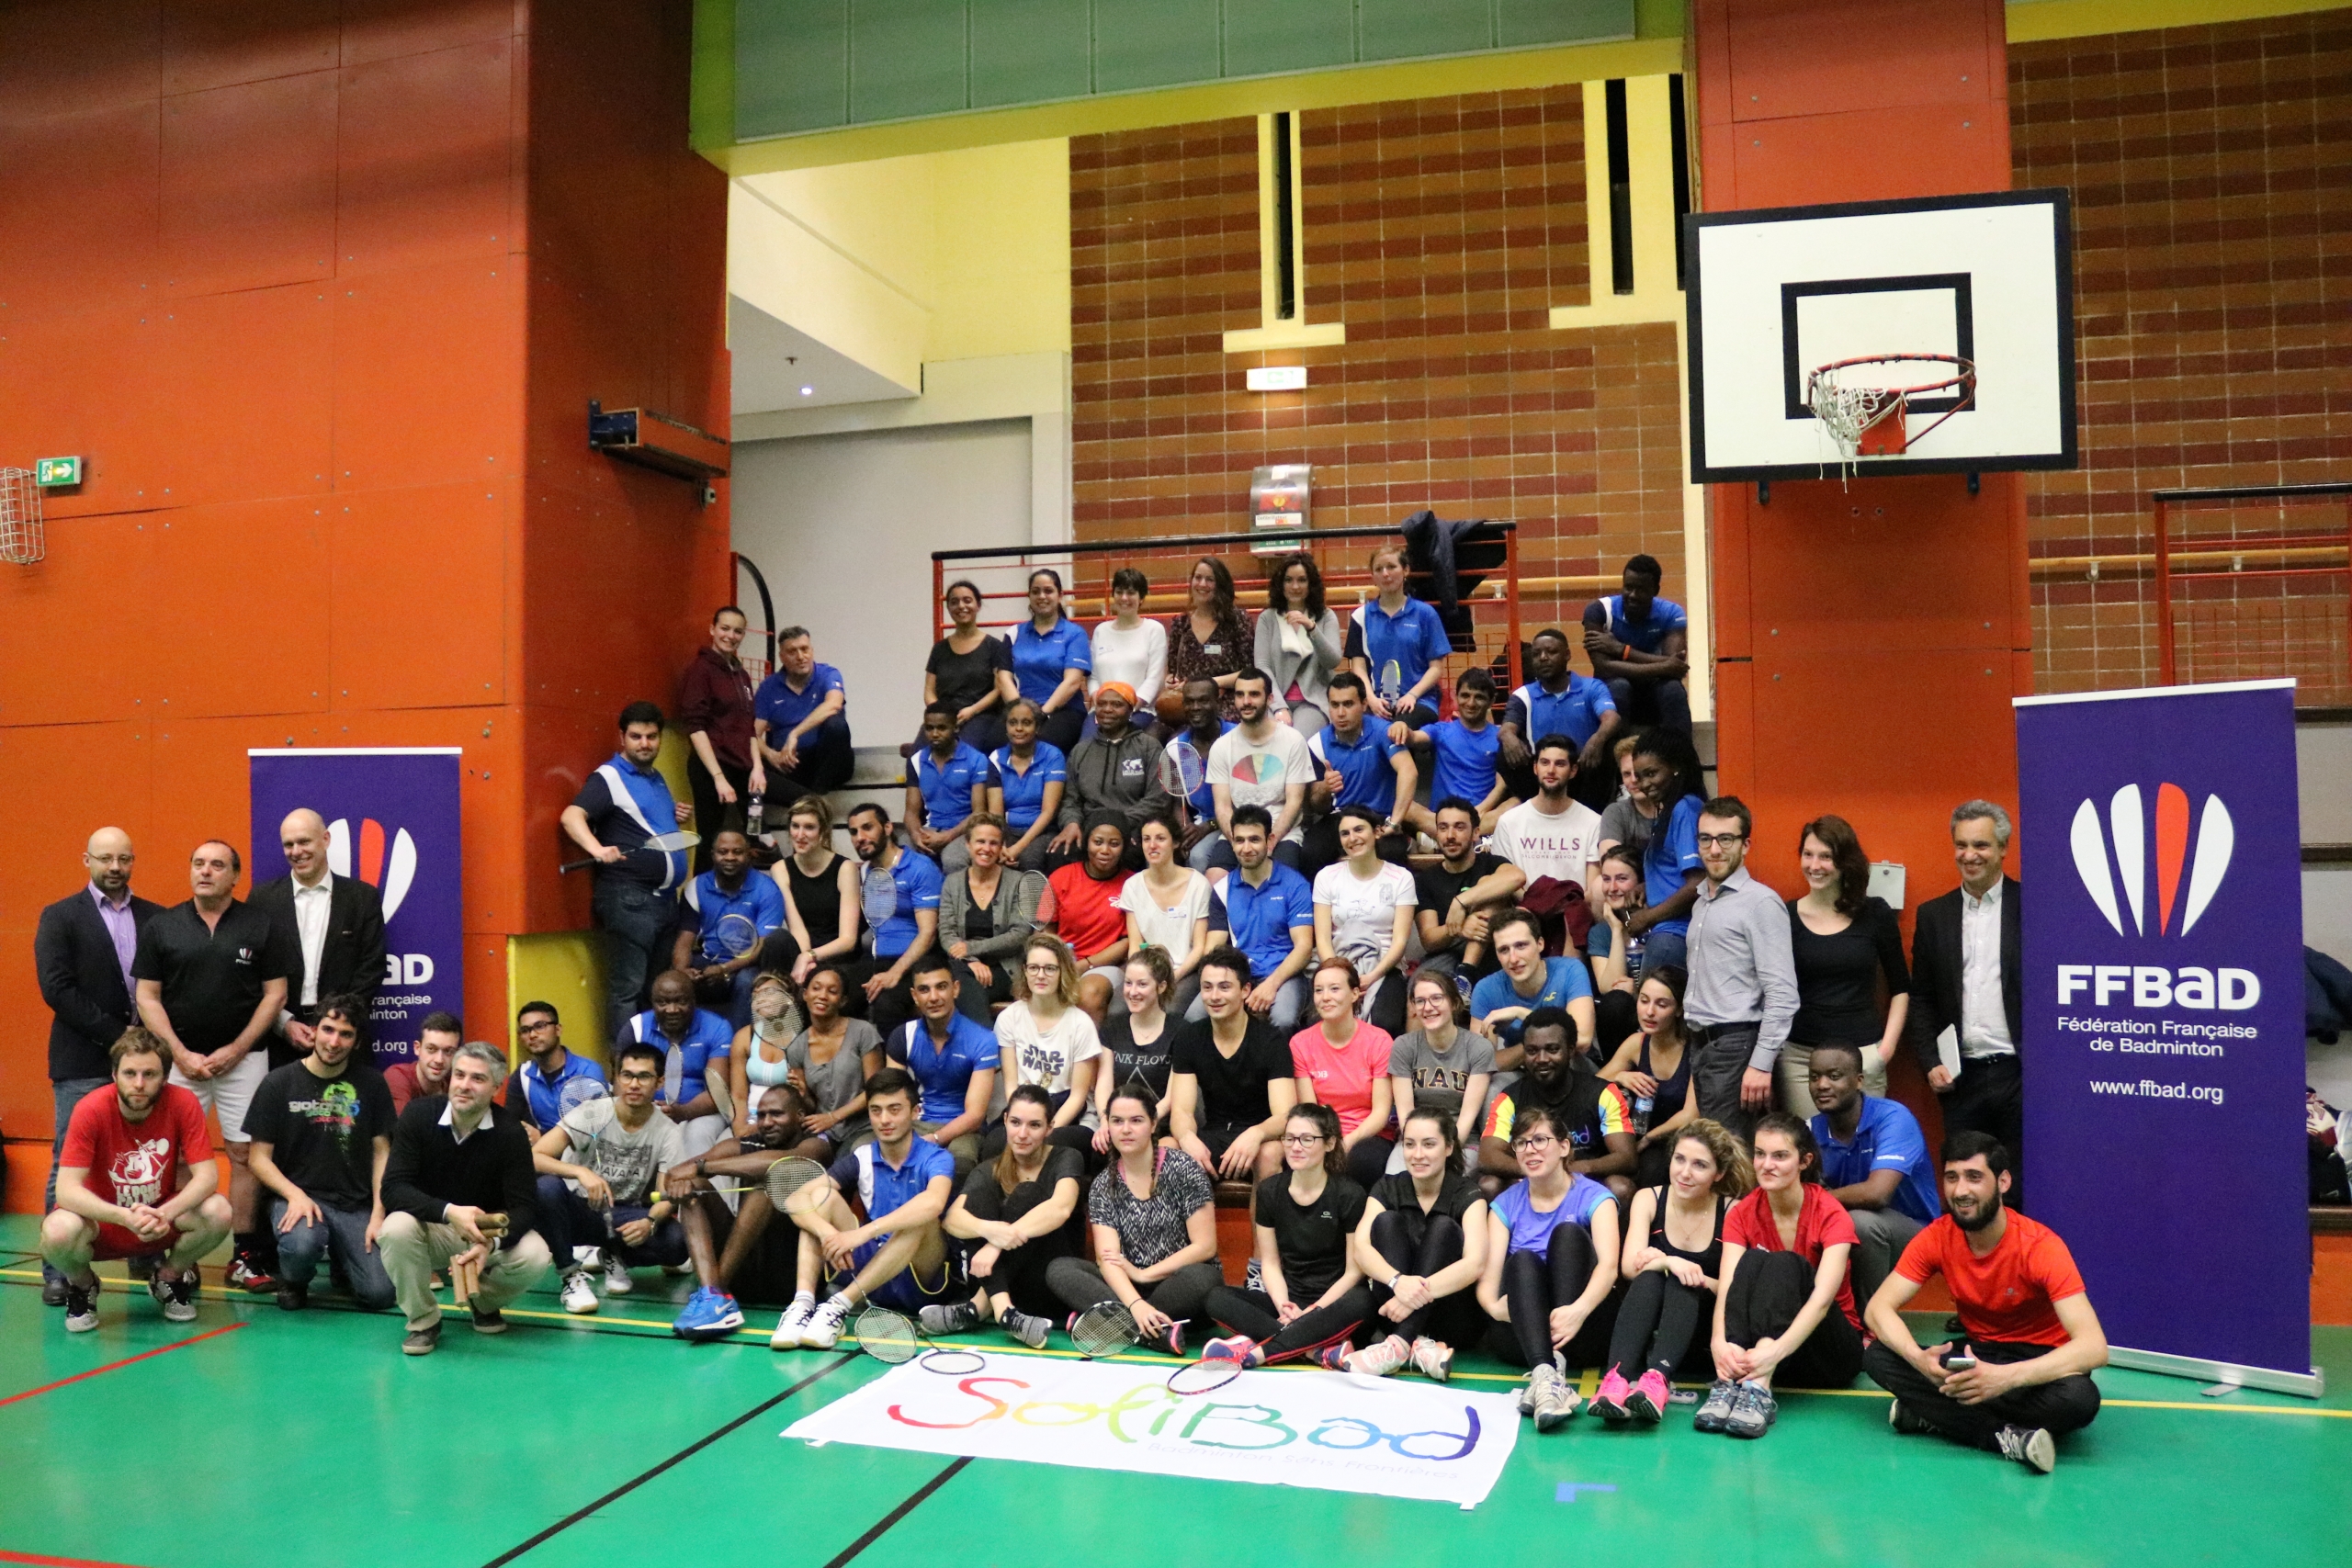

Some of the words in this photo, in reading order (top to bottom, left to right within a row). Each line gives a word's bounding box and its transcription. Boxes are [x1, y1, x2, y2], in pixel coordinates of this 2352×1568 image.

[1520, 837, 1580, 851] WILLS
[372, 993, 432, 1007] rançaise
[369, 1010, 408, 1020] inton
[2057, 1016, 2156, 1034] Fédération
[2162, 1021, 2258, 1040] Française
[1024, 1044, 1064, 1064] STAR
[2089, 1037, 2114, 1052] de
[2120, 1038, 2223, 1056] Badminton
[1023, 1054, 1064, 1077] WARS
[1114, 1051, 1134, 1065] NK
[2090, 1079, 2223, 1105] www.ffbad.org
[1148, 1442, 1272, 1461] Badminton
[1345, 1461, 1459, 1479] Frontières
